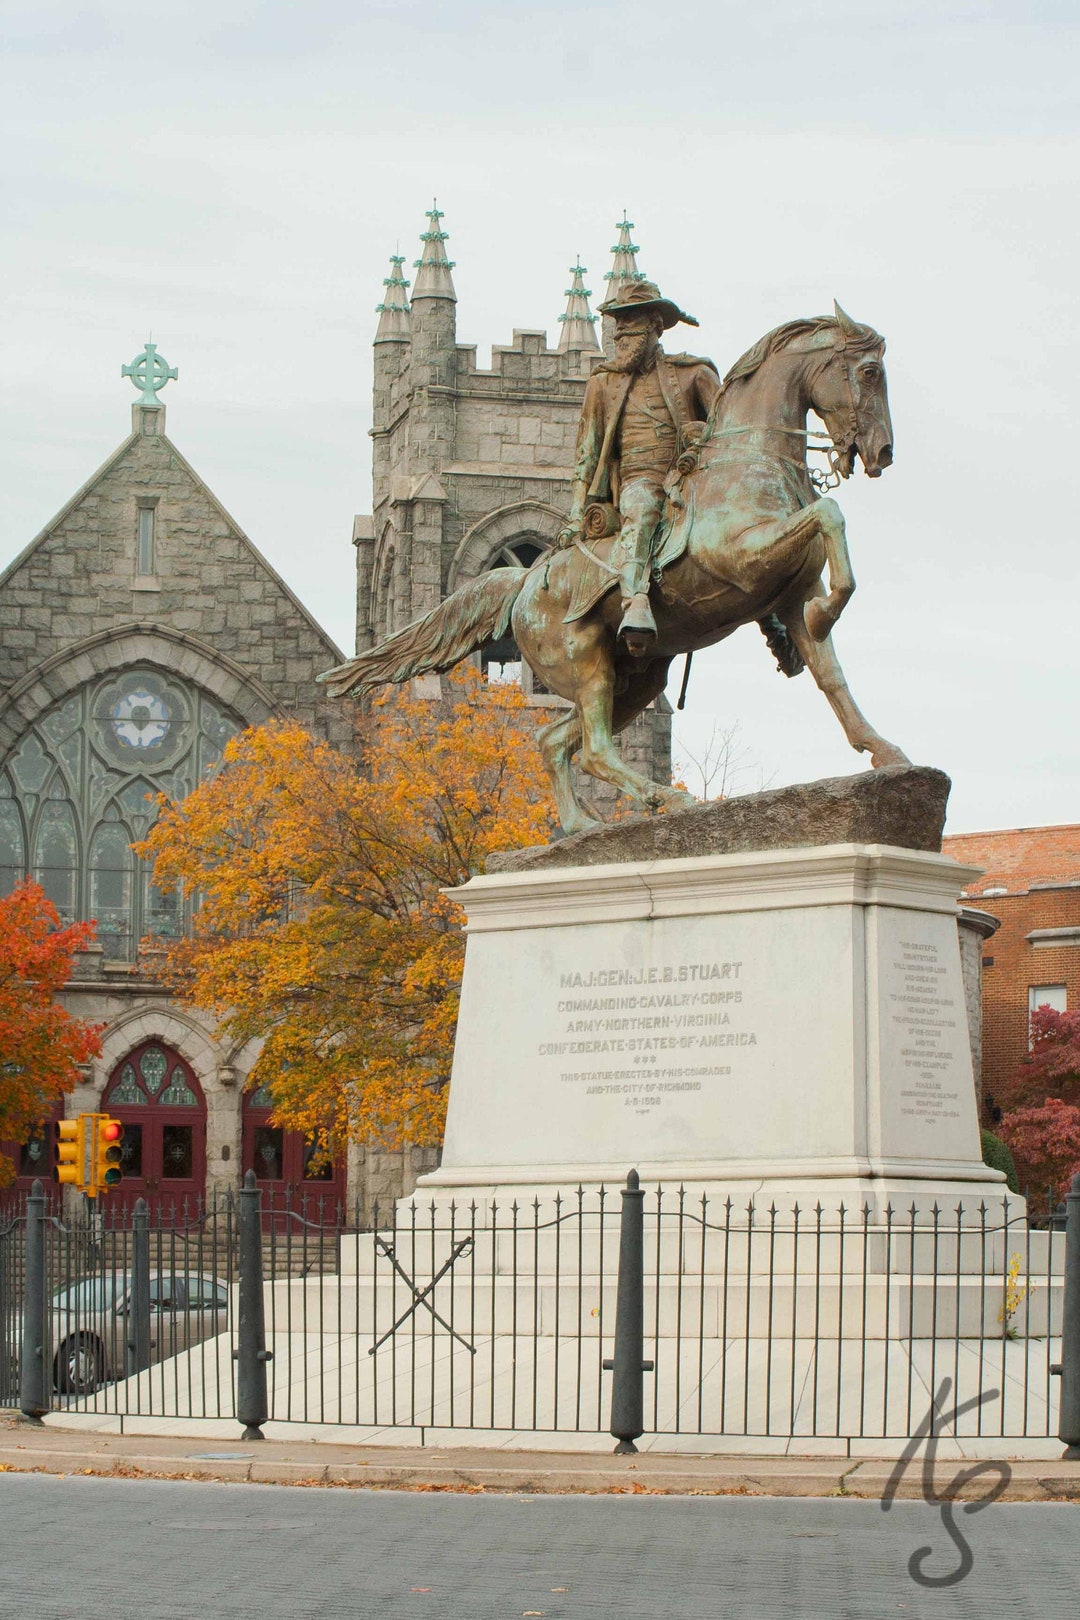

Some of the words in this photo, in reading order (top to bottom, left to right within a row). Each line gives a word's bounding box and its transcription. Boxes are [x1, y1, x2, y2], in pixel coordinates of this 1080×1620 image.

[678, 961, 743, 981] STUART
[557, 997, 636, 1012] COMMANDING
[639, 993, 699, 1008] CAVALRY
[701, 991, 743, 1005] CORPS
[566, 1019, 603, 1033] ARMY
[605, 1016, 670, 1031] NORTHERN
[674, 1012, 730, 1027] VIRGINIA
[538, 1039, 624, 1056] CONFEDERATE
[628, 1036, 677, 1051] STATES
[680, 1036, 696, 1049] OF
[699, 1032, 757, 1048] AMERICA
